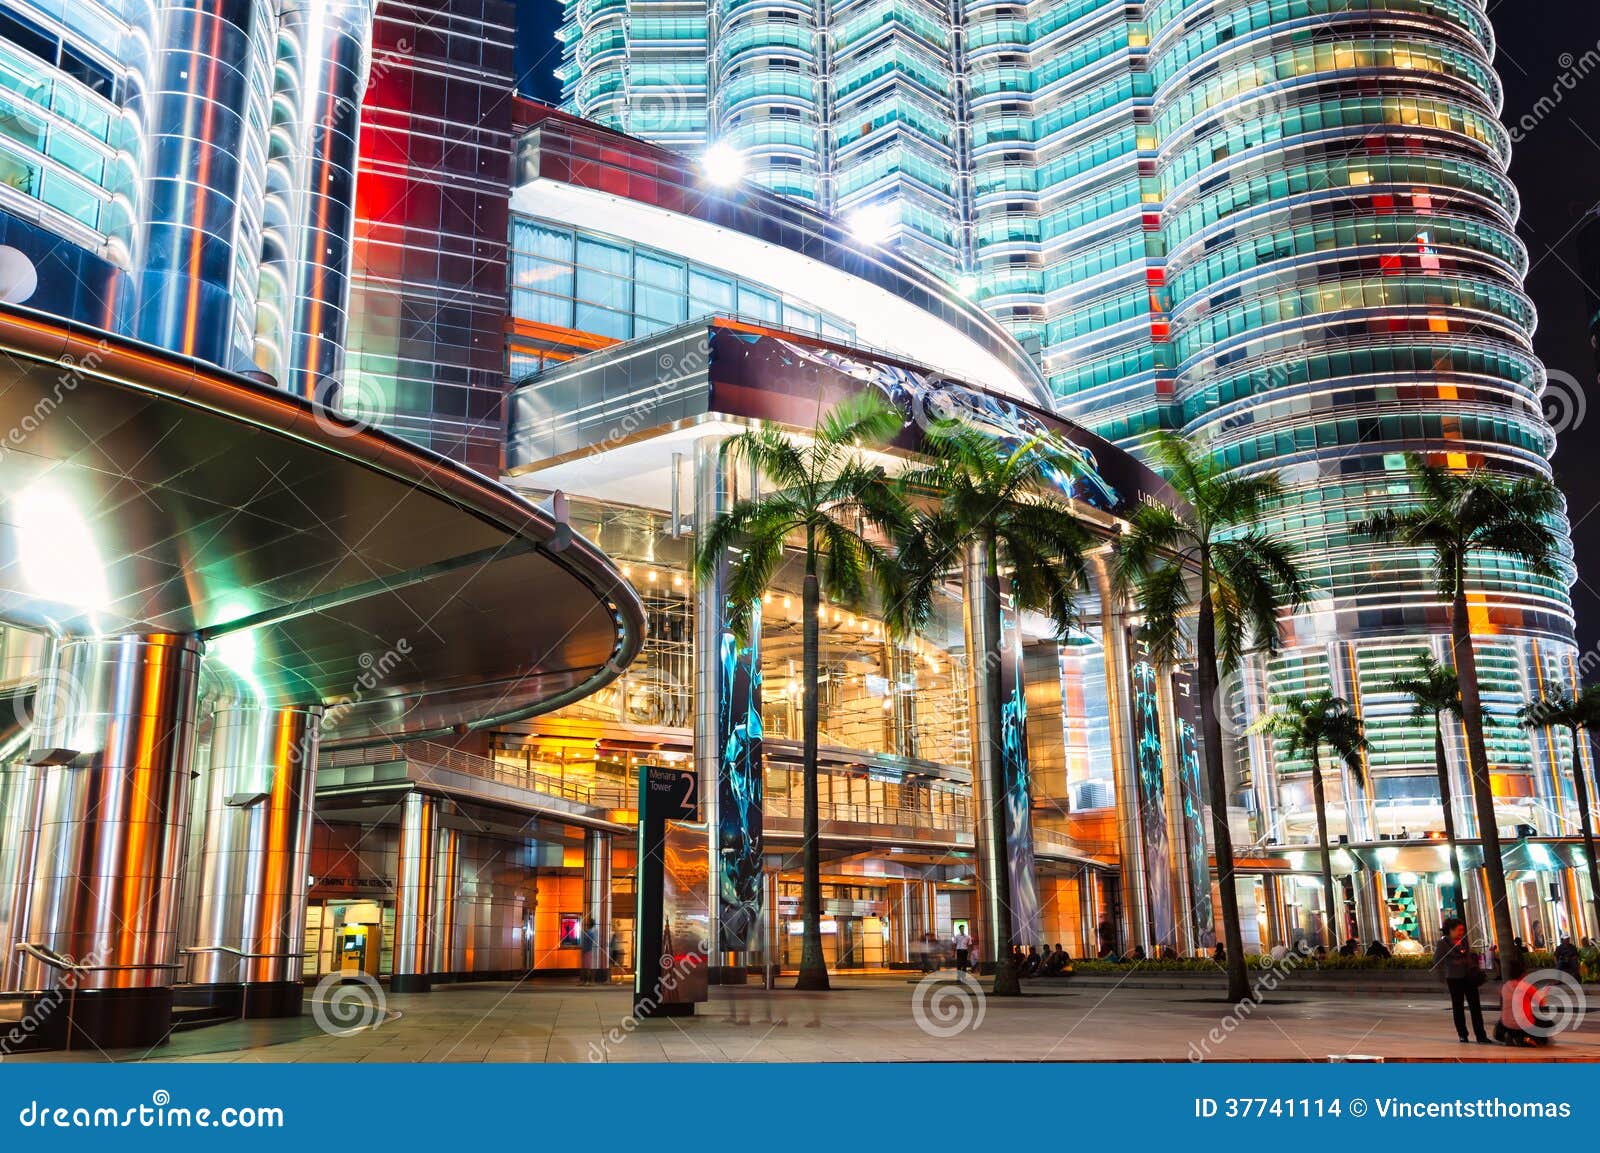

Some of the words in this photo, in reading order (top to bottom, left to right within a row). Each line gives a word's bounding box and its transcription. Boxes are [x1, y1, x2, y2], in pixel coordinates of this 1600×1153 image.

[649, 768, 676, 781] Menara
[649, 780, 673, 792] Tower
[680, 773, 695, 808] 2
